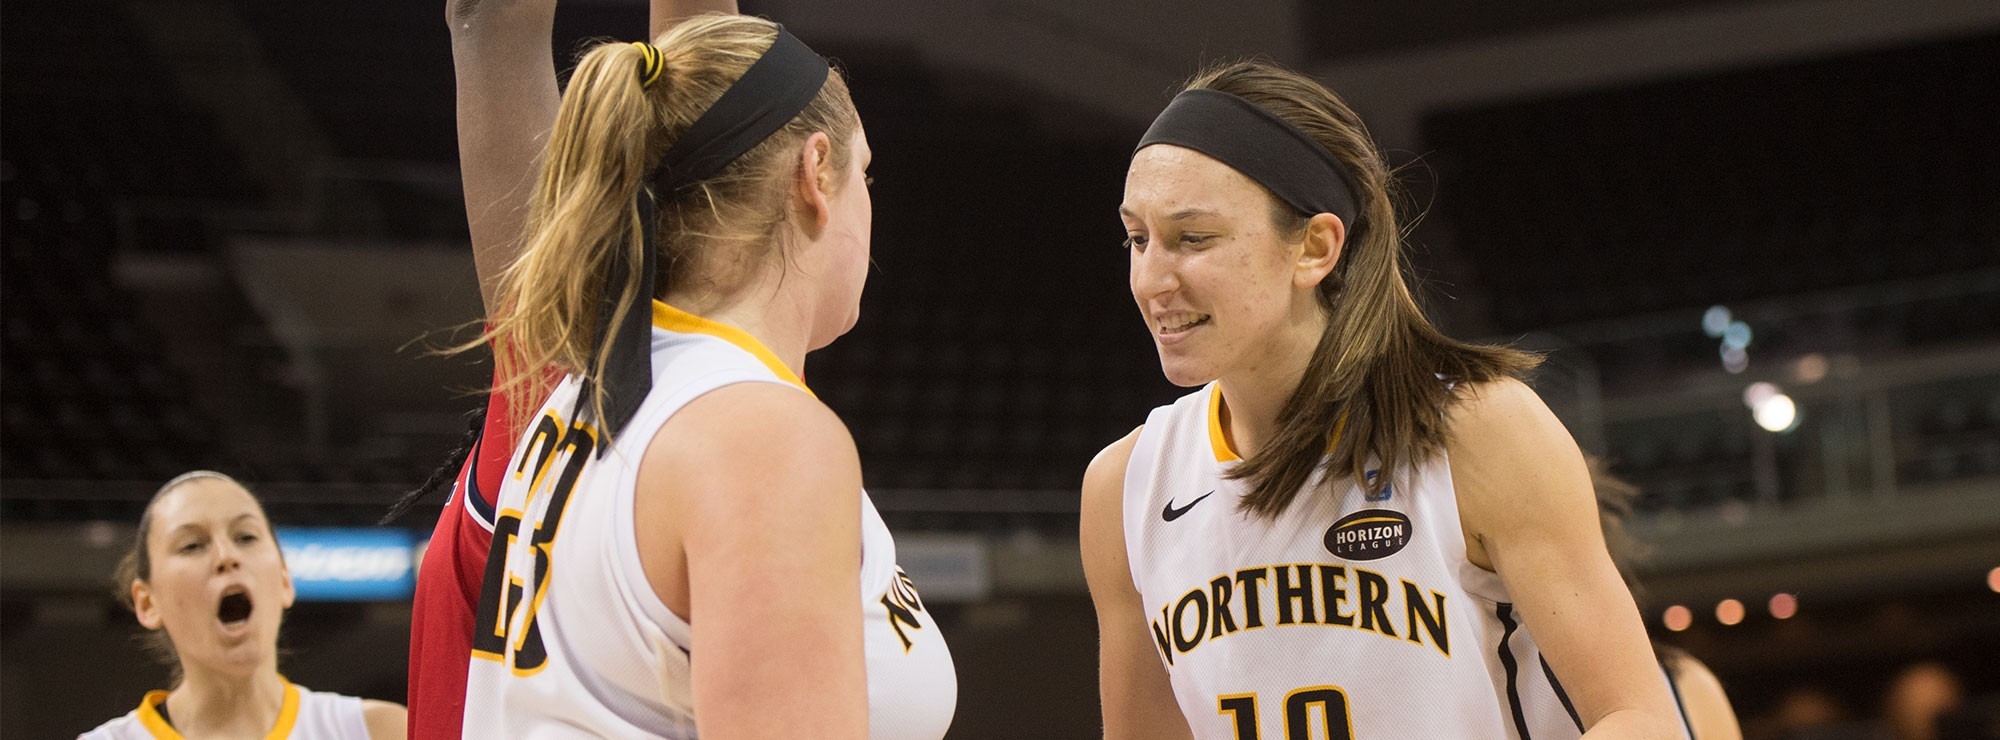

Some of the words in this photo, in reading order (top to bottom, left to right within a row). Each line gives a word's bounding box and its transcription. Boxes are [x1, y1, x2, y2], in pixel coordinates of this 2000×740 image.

[1336, 524, 1403, 544] HORIZON
[1337, 537, 1403, 553] LEAGUE
[880, 570, 922, 655] NO
[1152, 563, 1451, 666] NORTHERN
